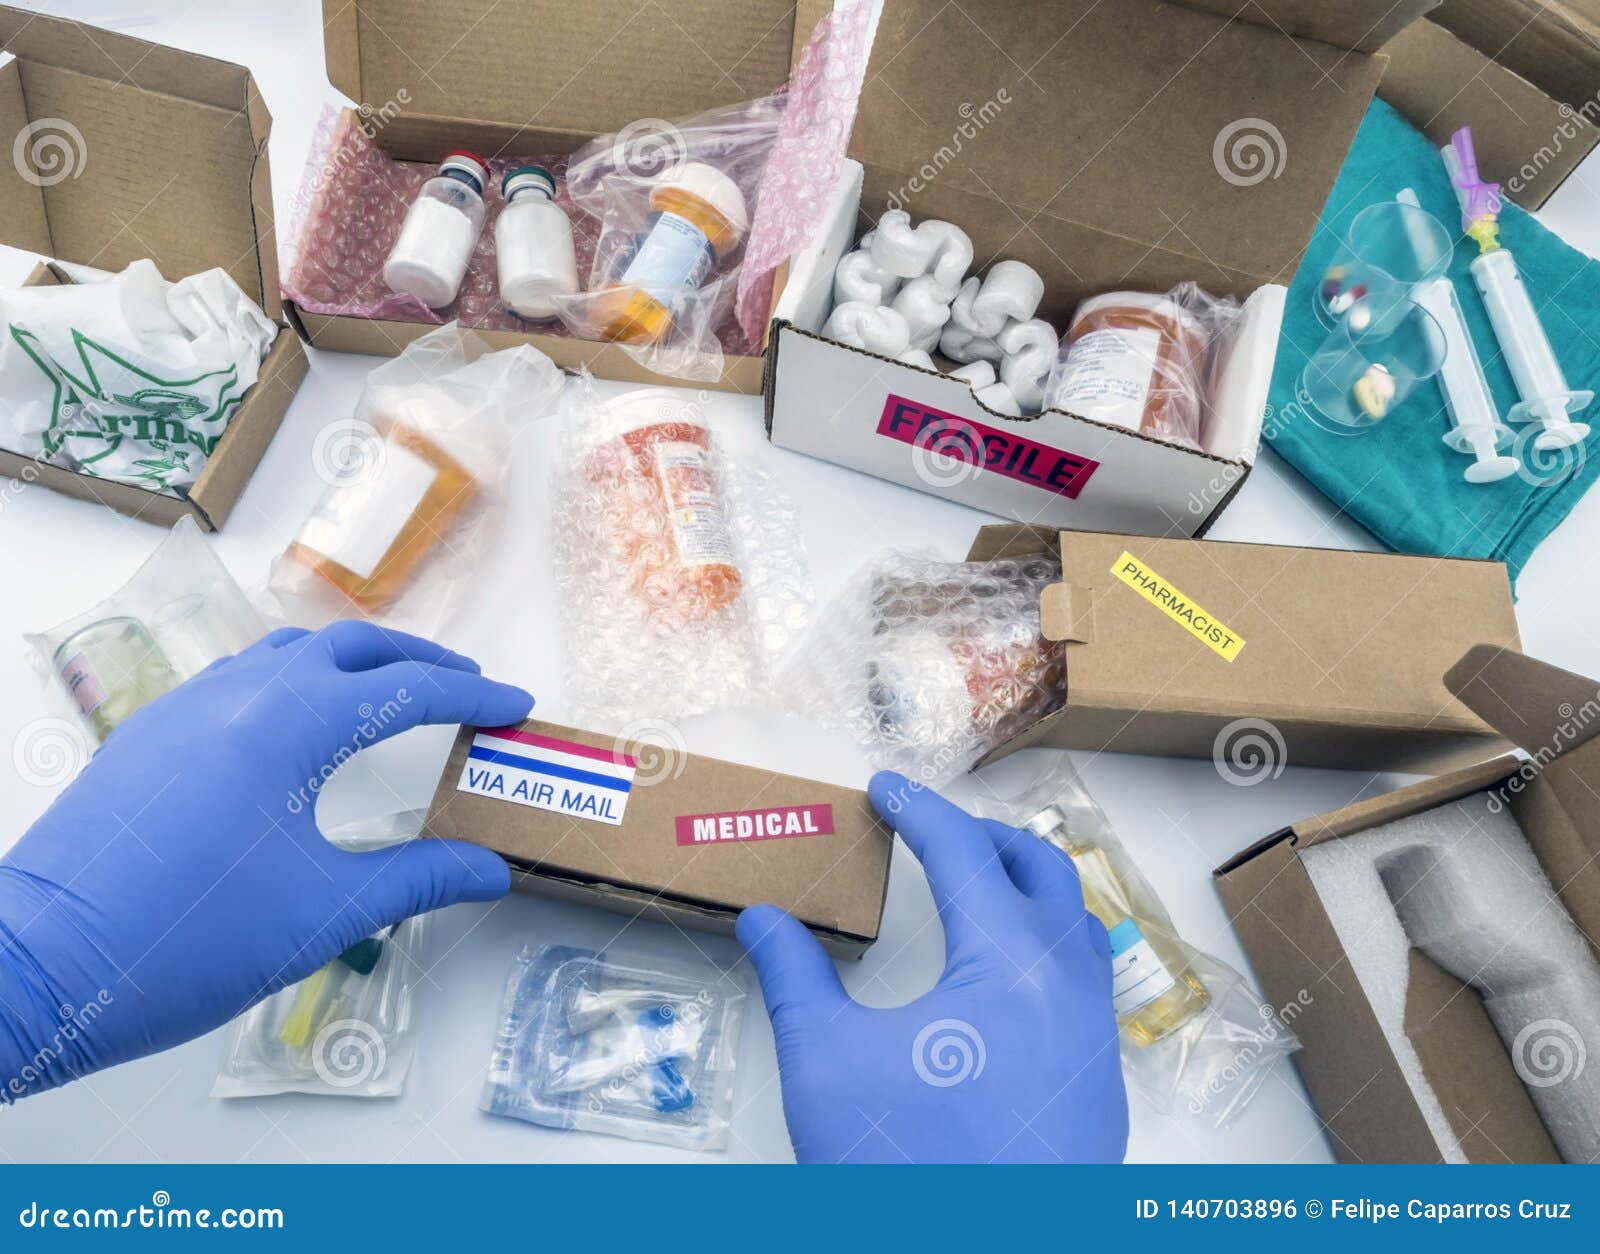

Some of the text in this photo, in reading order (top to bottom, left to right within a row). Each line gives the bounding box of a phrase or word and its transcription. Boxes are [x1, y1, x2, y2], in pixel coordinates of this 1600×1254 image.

[888, 403, 1083, 491] FRAGILE
[1122, 562, 1235, 649] PHARMACIST
[468, 767, 617, 820] VIA AIR MAIL
[693, 811, 819, 841] MEDICAL
